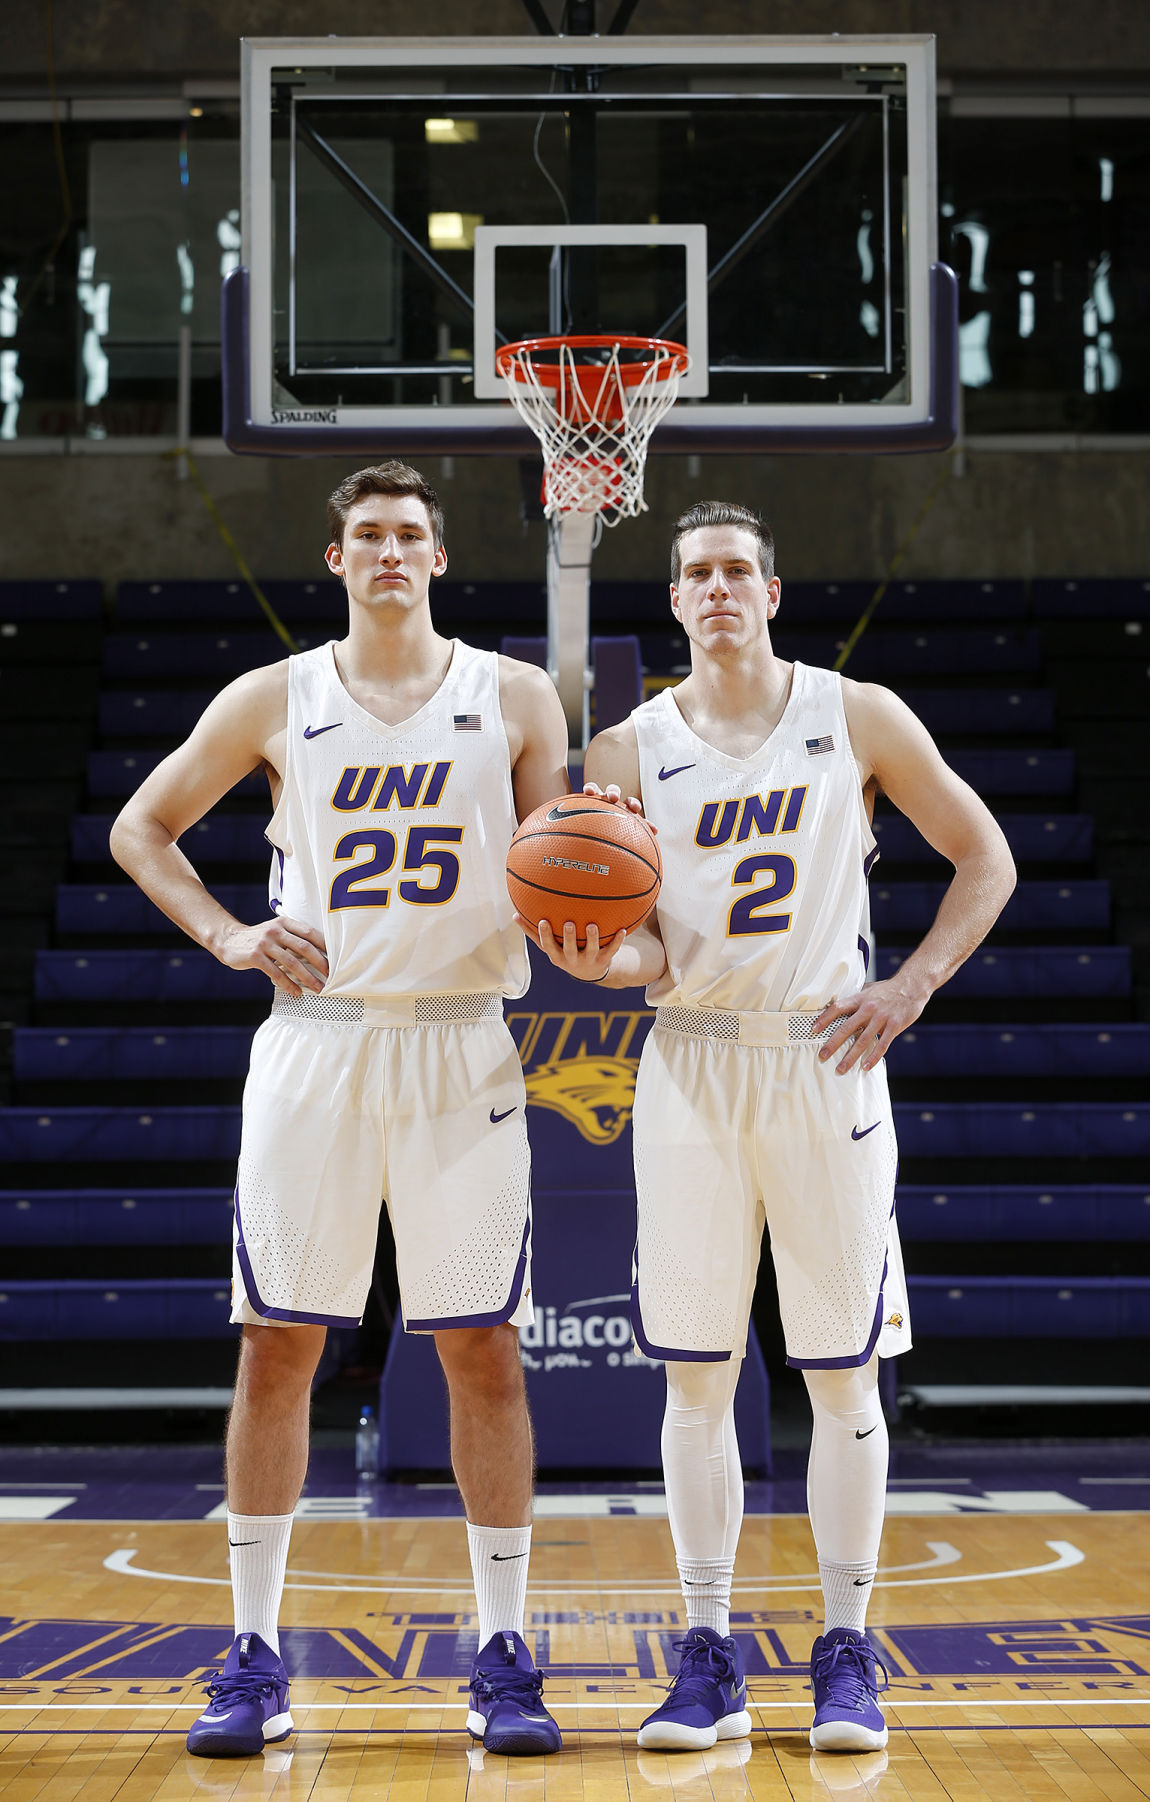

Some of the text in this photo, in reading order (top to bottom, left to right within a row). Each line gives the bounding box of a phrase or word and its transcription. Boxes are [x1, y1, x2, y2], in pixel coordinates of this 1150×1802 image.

[271, 409, 337, 424] SPALDING
[330, 760, 455, 813] UNI
[694, 784, 810, 849] UNI
[328, 825, 465, 913] 25
[725, 852, 797, 938] 2
[505, 1011, 657, 1066] UNI
